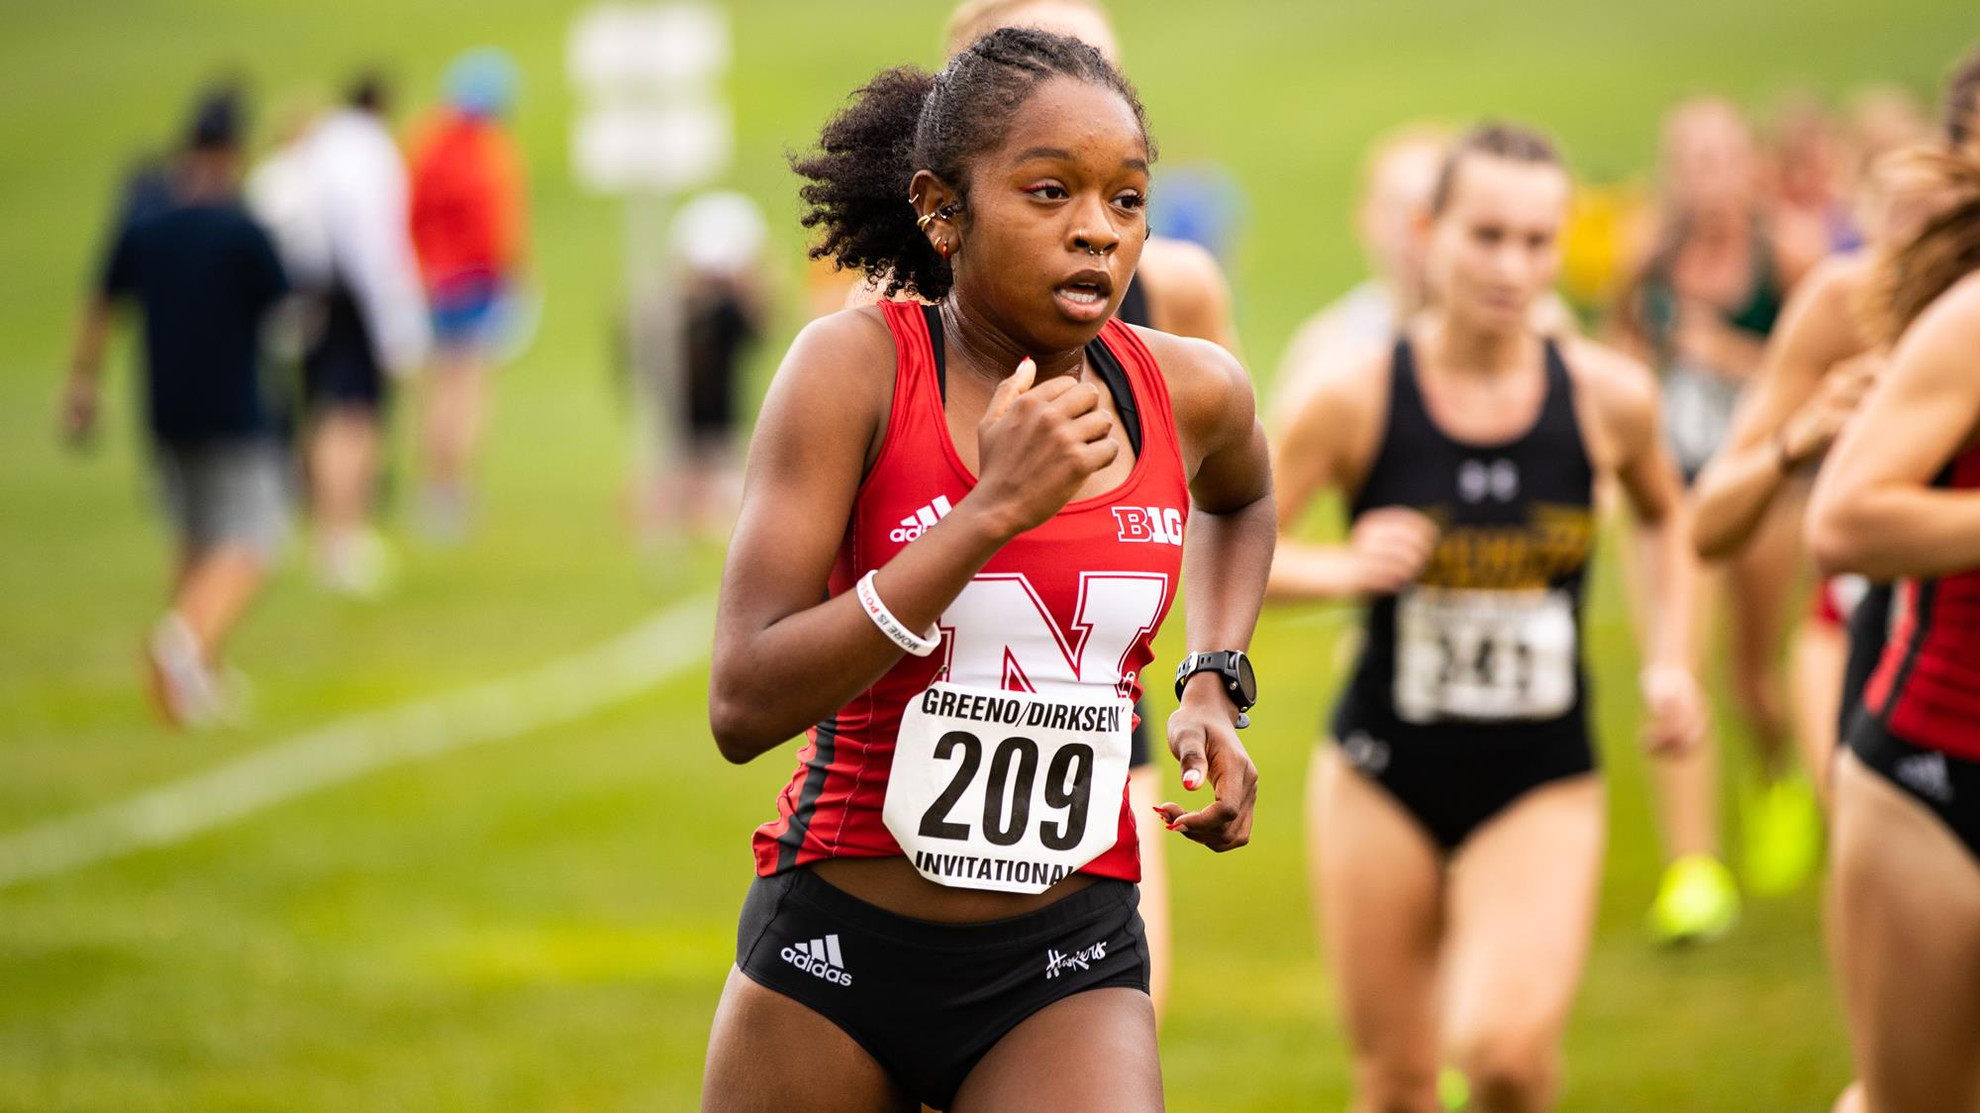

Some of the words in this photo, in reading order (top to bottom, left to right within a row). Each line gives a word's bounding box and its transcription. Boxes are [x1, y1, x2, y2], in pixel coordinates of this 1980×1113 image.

[940, 571, 1168, 696] N
[918, 730, 1094, 851] 209
[780, 946, 853, 987] adidas
